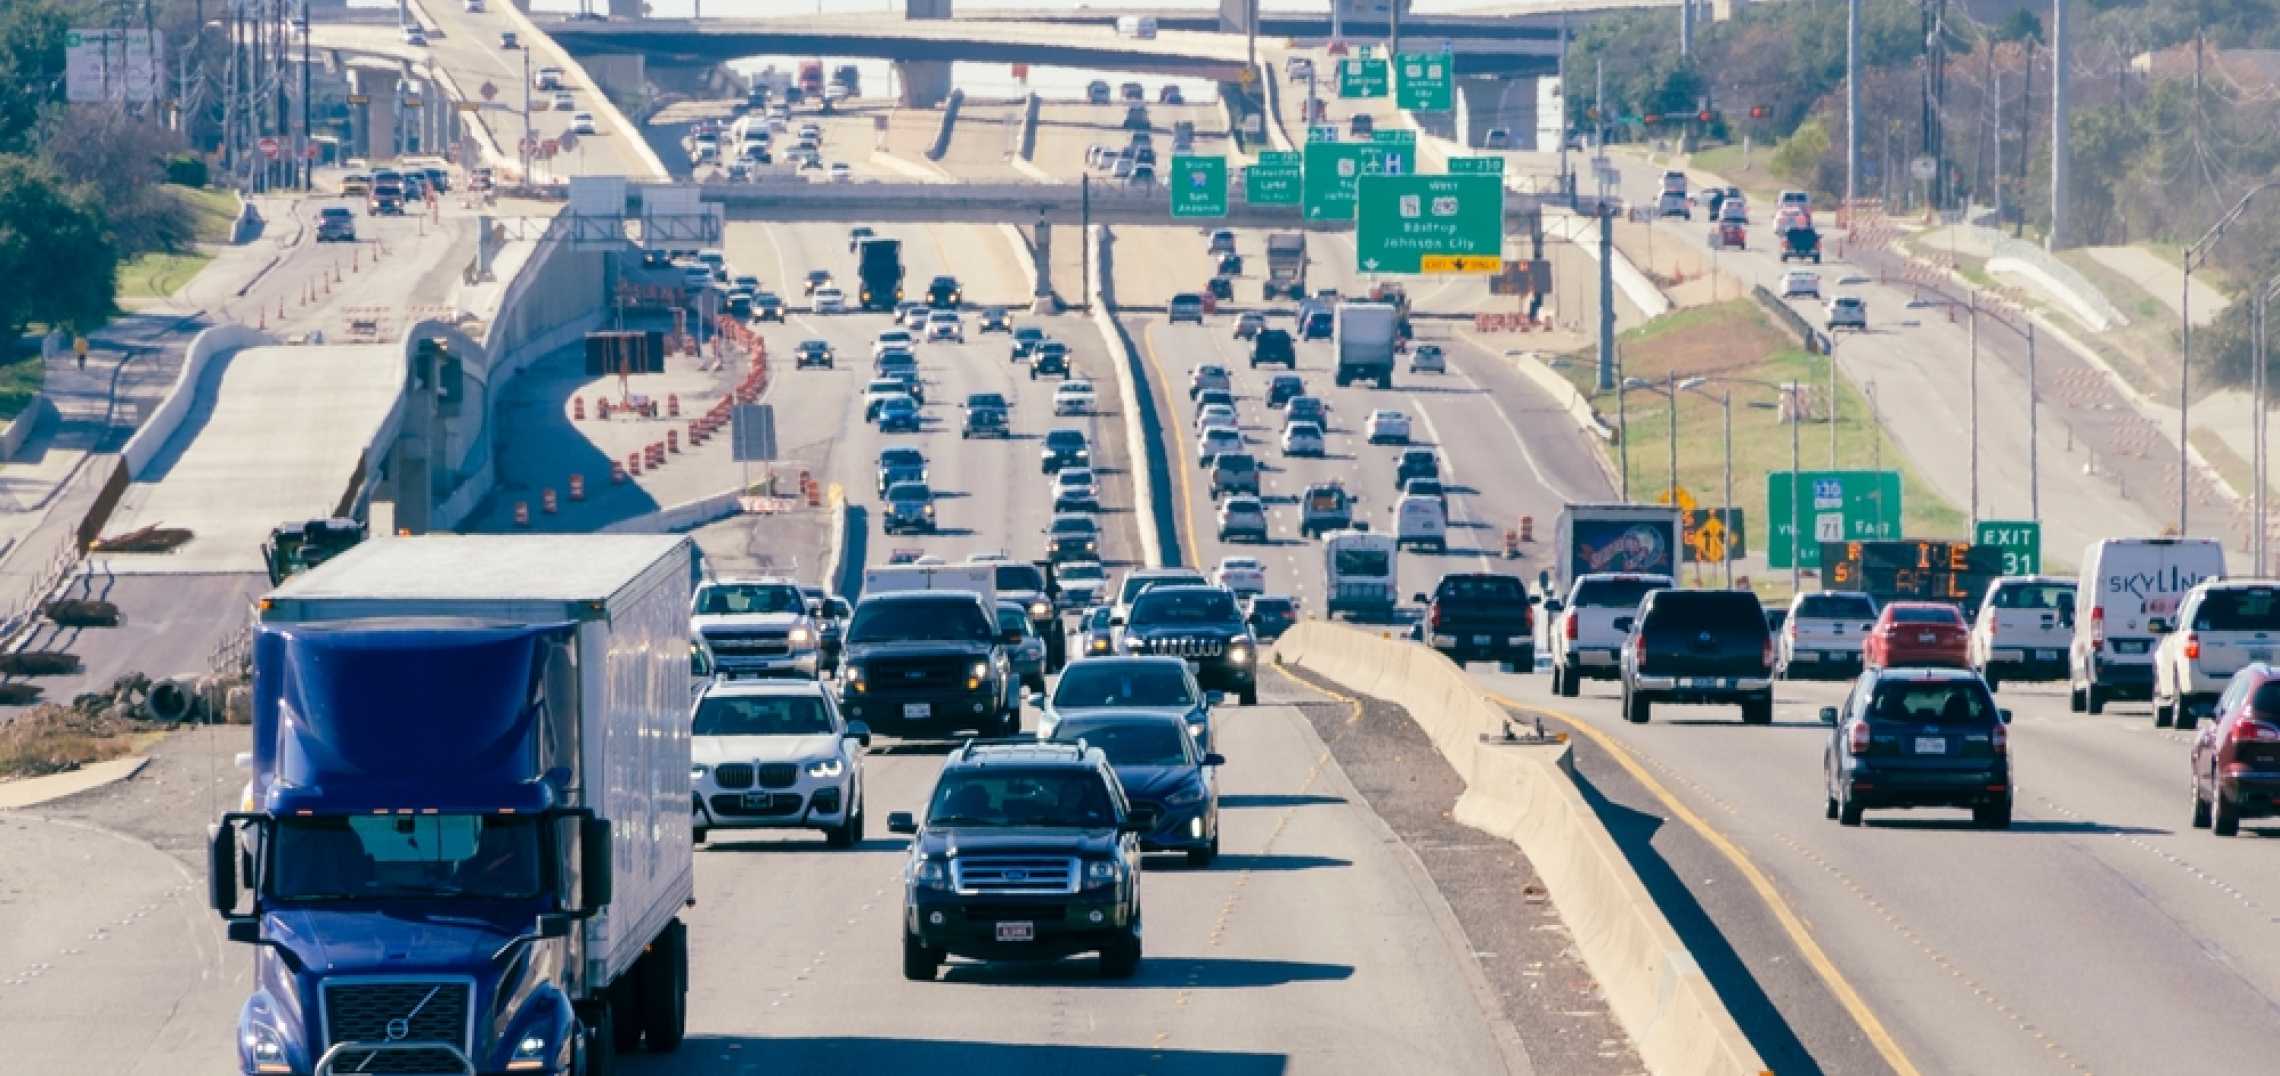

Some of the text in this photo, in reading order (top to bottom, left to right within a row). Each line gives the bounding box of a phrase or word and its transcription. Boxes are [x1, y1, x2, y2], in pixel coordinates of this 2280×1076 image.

[1404, 222, 1457, 235] Bastrop
[1384, 238, 1475, 249] Johnson City
[1823, 523, 1840, 539] 71
[1983, 529, 2032, 545] EXIT
